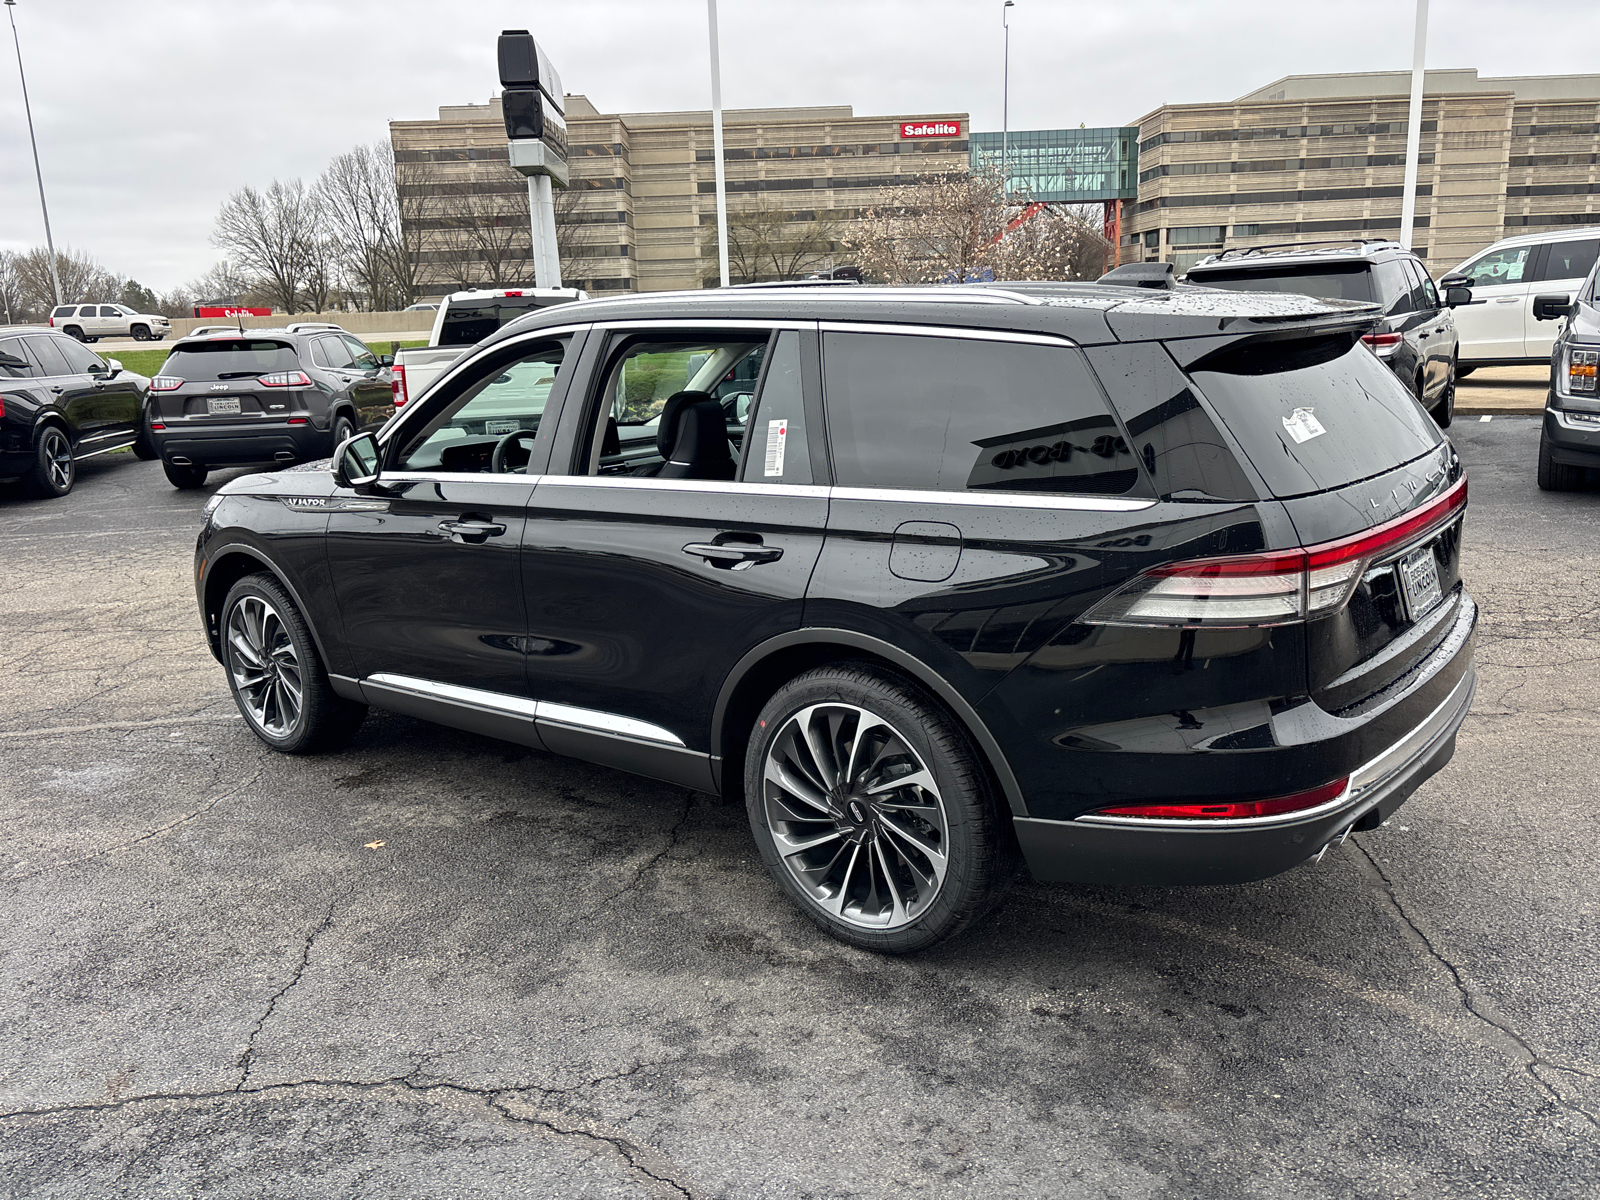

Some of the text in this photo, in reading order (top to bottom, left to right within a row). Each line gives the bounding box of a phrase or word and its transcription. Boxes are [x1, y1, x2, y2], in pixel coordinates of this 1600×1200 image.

[904, 123, 957, 136] Safelite
[210, 383, 229, 391] Jeep
[288, 498, 326, 507] AVIATOR
[1411, 569, 1437, 596] LINCOLN
